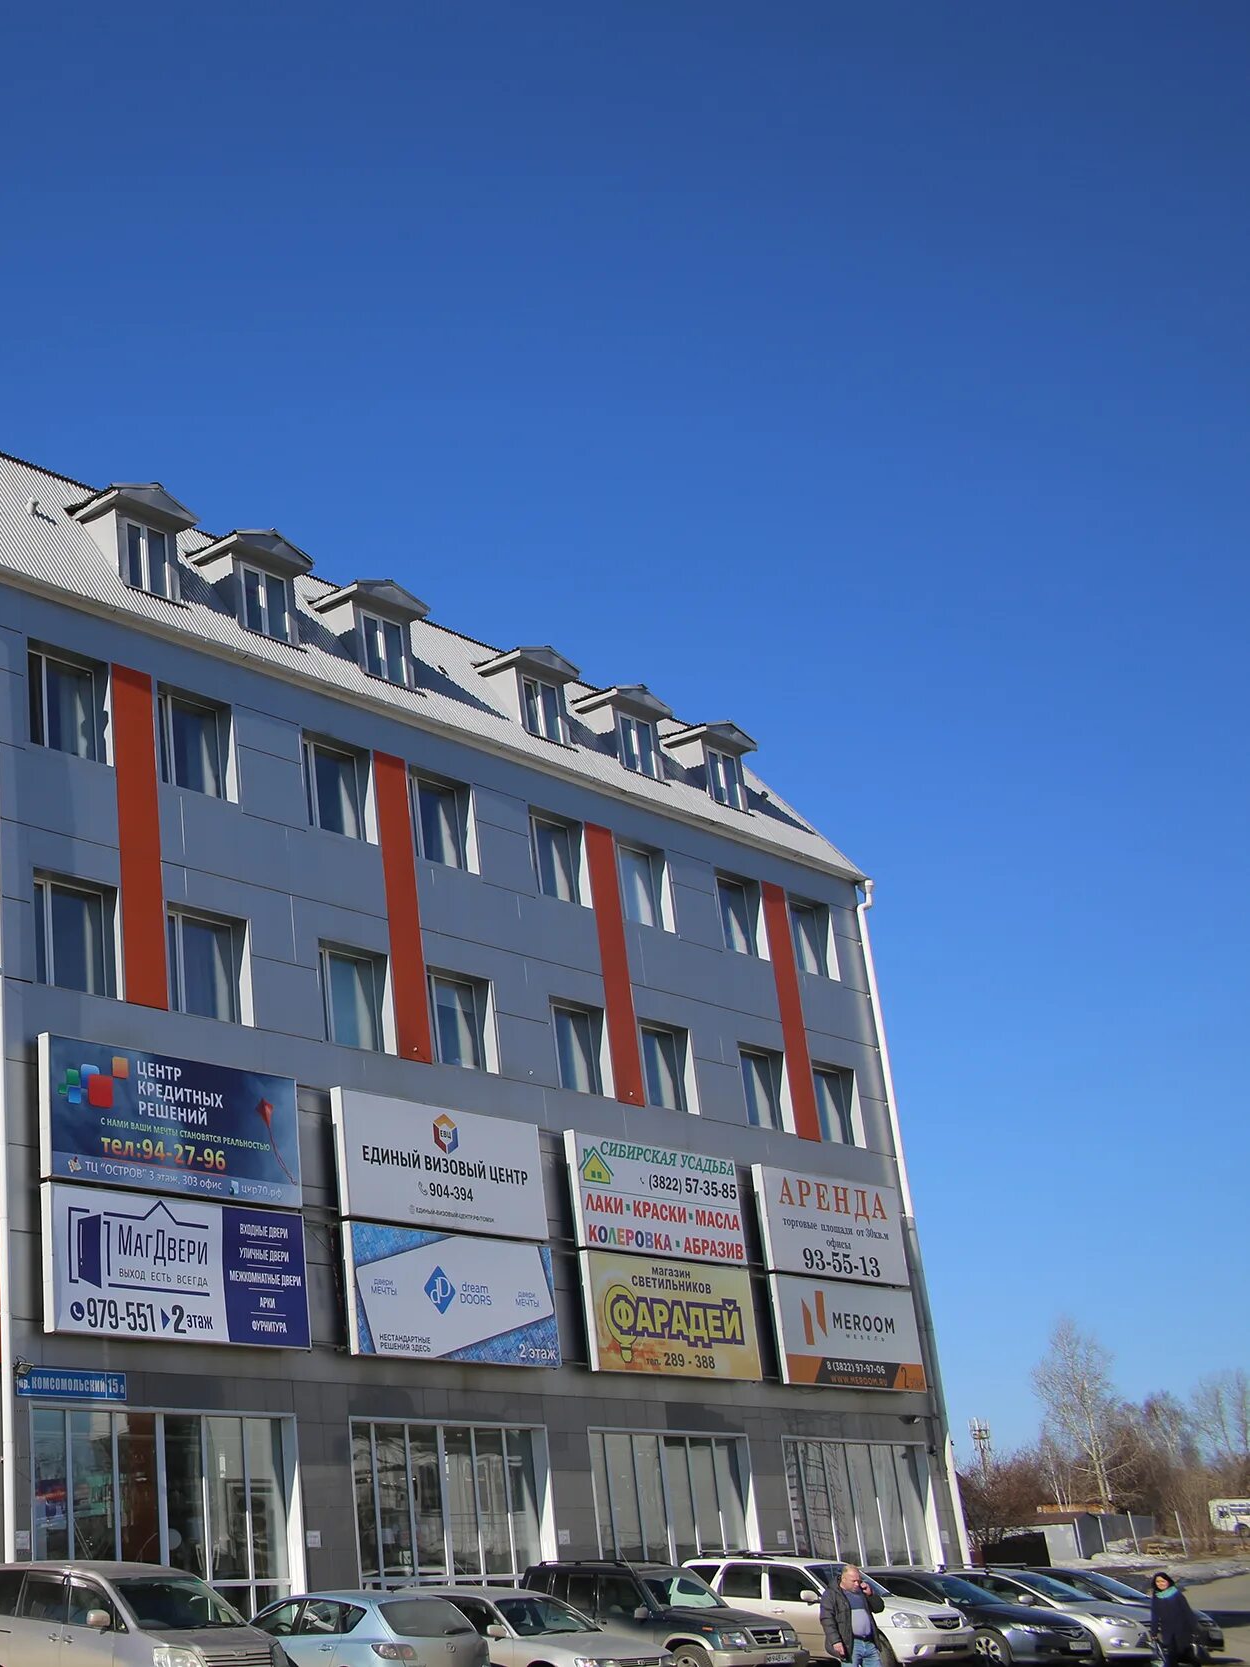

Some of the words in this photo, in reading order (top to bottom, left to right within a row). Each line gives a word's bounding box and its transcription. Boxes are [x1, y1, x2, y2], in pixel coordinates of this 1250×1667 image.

[137, 1060, 182, 1082] ЦЕНТР
[137, 1081, 223, 1109] КРЕДИТНЫХ
[138, 1101, 208, 1126] РЕШЕНИЙ
[100, 1117, 106, 1126] С
[107, 1118, 129, 1129] НАМИ
[131, 1121, 152, 1133] ВАШИ
[153, 1125, 179, 1137] МЕЧТЫ
[179, 1129, 222, 1144] СТАНОВЯТСЯ
[222, 1137, 271, 1151] РЕАЛЬНОСТЬЮ
[362, 1144, 421, 1169] ЕДИНЫЙ
[425, 1155, 486, 1179] ВИЗОВЫЙ
[489, 1165, 528, 1186] ЦЕНТР
[600, 1140, 677, 1167] СИБИРСКАЯ
[680, 1154, 735, 1176] УСАДЬБА
[85, 1161, 98, 1175] ТЦ
[149, 1170, 155, 1181] 3
[182, 1176, 198, 1187] 303
[200, 1179, 222, 1191] офис
[429, 1182, 473, 1201] 904-394
[649, 1174, 682, 1195] (3822)
[685, 1177, 737, 1200] 57-35-85
[779, 1176, 888, 1225] АРЕНДА
[586, 1192, 623, 1215] ЛАКИ
[633, 1200, 686, 1224] КРАСКИ
[695, 1209, 740, 1231] МАСЛА
[239, 1223, 268, 1237] ВХОДНЫЕ
[269, 1227, 288, 1239] ДВЕРИ
[782, 1217, 818, 1230] торговые
[820, 1223, 853, 1236] площади
[588, 1224, 672, 1251] КОЛЕРОВКА
[684, 1236, 744, 1260] АБРАЗИВ
[826, 1238, 851, 1250] офисы
[239, 1247, 268, 1261] УЛИЧНЫЕ
[269, 1250, 289, 1263] ДВЕРИ
[802, 1247, 881, 1278] 93-55-13
[119, 1268, 145, 1281] ВЫХОД
[151, 1271, 172, 1283] ЕСТЬ
[177, 1275, 208, 1287] ВСЕГДА
[229, 1270, 280, 1286] МЕЖКОМНАТНЫЕ
[281, 1275, 301, 1287] ДВЕРИ
[651, 1266, 691, 1279] магазин
[371, 1285, 397, 1296] МЕЧТЫ
[461, 1281, 489, 1294] dream
[631, 1275, 712, 1294] СВЕТИЛЬНИКОВ
[259, 1296, 276, 1309] АРКИ
[460, 1293, 492, 1306] DOORS
[515, 1298, 540, 1308] МЕЧТЫ
[86, 1297, 156, 1332] 979-551
[171, 1304, 187, 1334] 2
[186, 1313, 213, 1330] этаж
[613, 1300, 742, 1344] ФАРАДЕЙ
[832, 1312, 895, 1334] MEROOM
[251, 1320, 287, 1333] ФУРНИТУРА
[379, 1333, 431, 1345] НЕСТАНДАРТНЫЕ
[380, 1341, 410, 1351] РЕШЕНИЯ
[411, 1344, 431, 1353] ЗДЕСЬ
[519, 1343, 527, 1358] 2
[528, 1347, 557, 1360] этаж
[664, 1353, 685, 1367] 289
[695, 1355, 716, 1369] 388
[826, 1361, 831, 1370] 8
[832, 1361, 855, 1373] (3822)
[855, 1363, 886, 1375] 97-97-06
[31, 1376, 106, 1393] КОМСОМОЛЬСКИЙ
[107, 1378, 119, 1393] 15
[831, 1375, 888, 1387] WWW.MEROOM.RU
